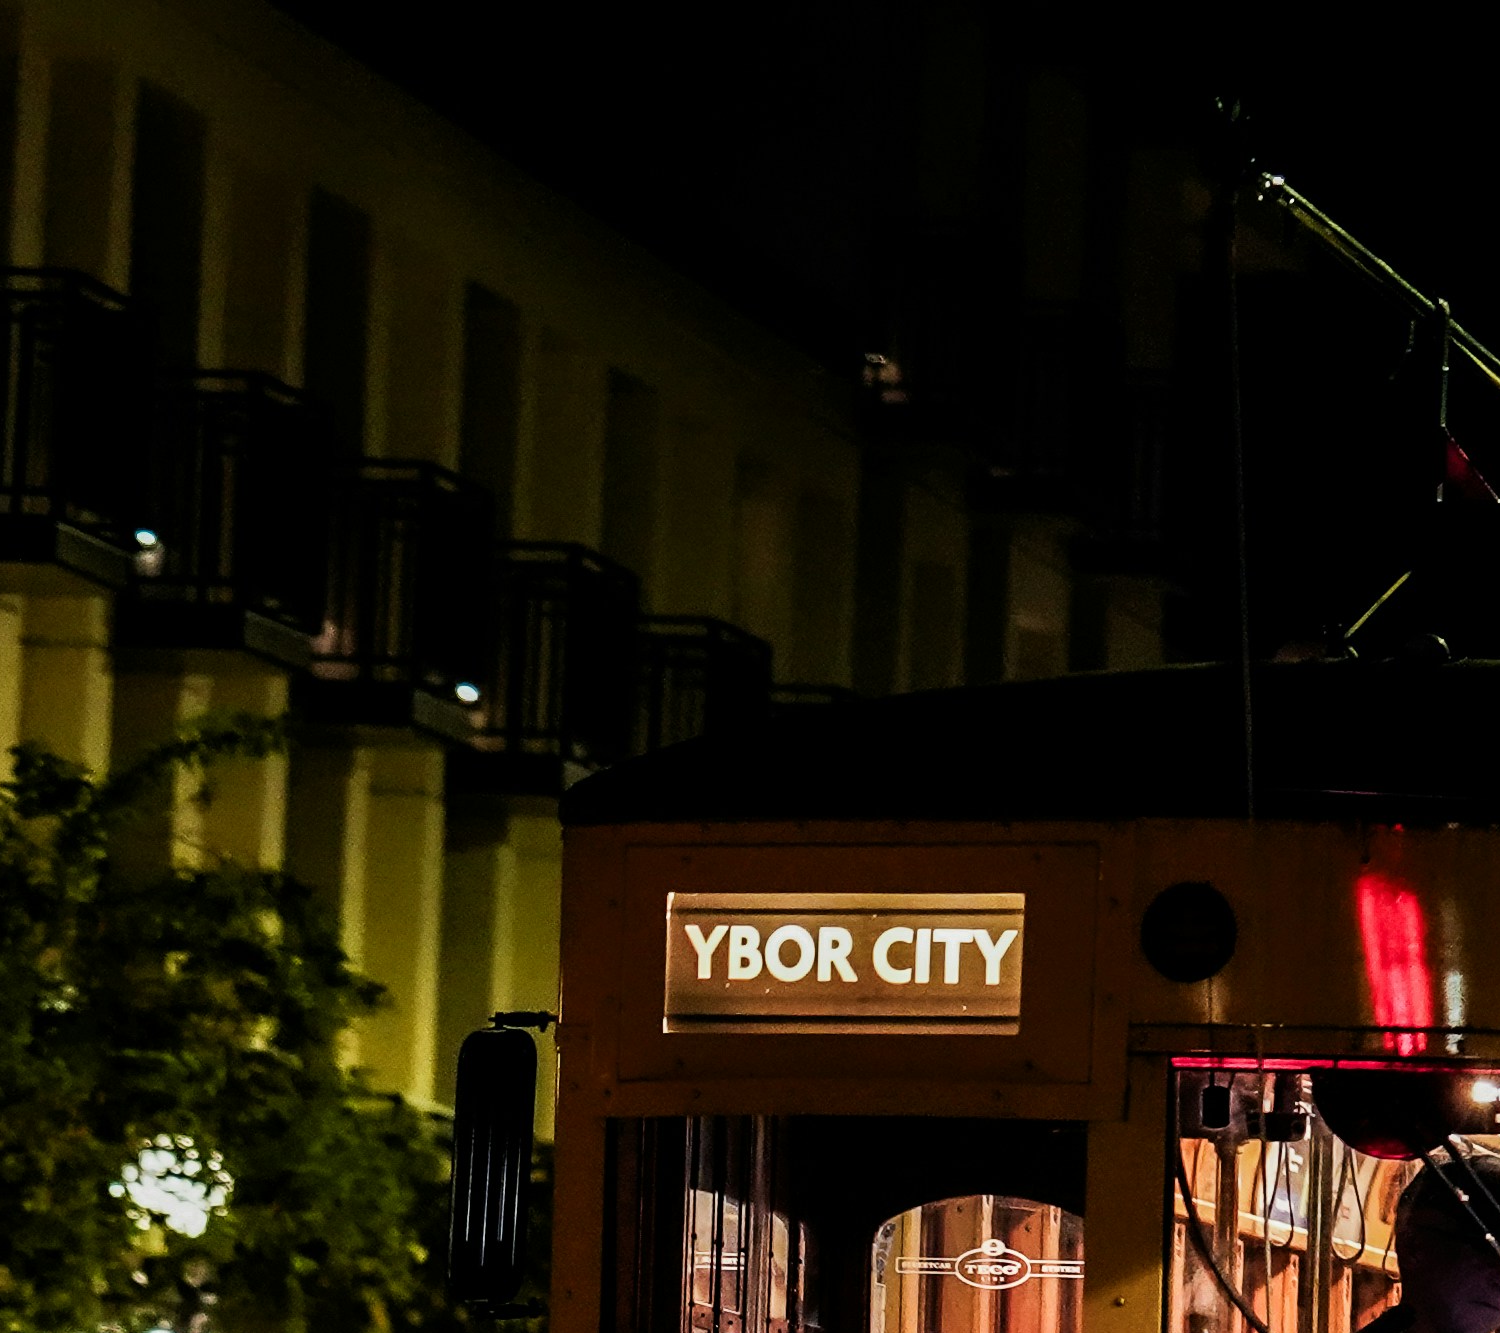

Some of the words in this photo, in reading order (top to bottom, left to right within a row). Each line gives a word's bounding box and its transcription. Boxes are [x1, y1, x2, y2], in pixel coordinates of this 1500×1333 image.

[685, 924, 858, 983] YBOR
[872, 926, 1019, 986] CITY
[964, 1261, 1020, 1276] TECO
